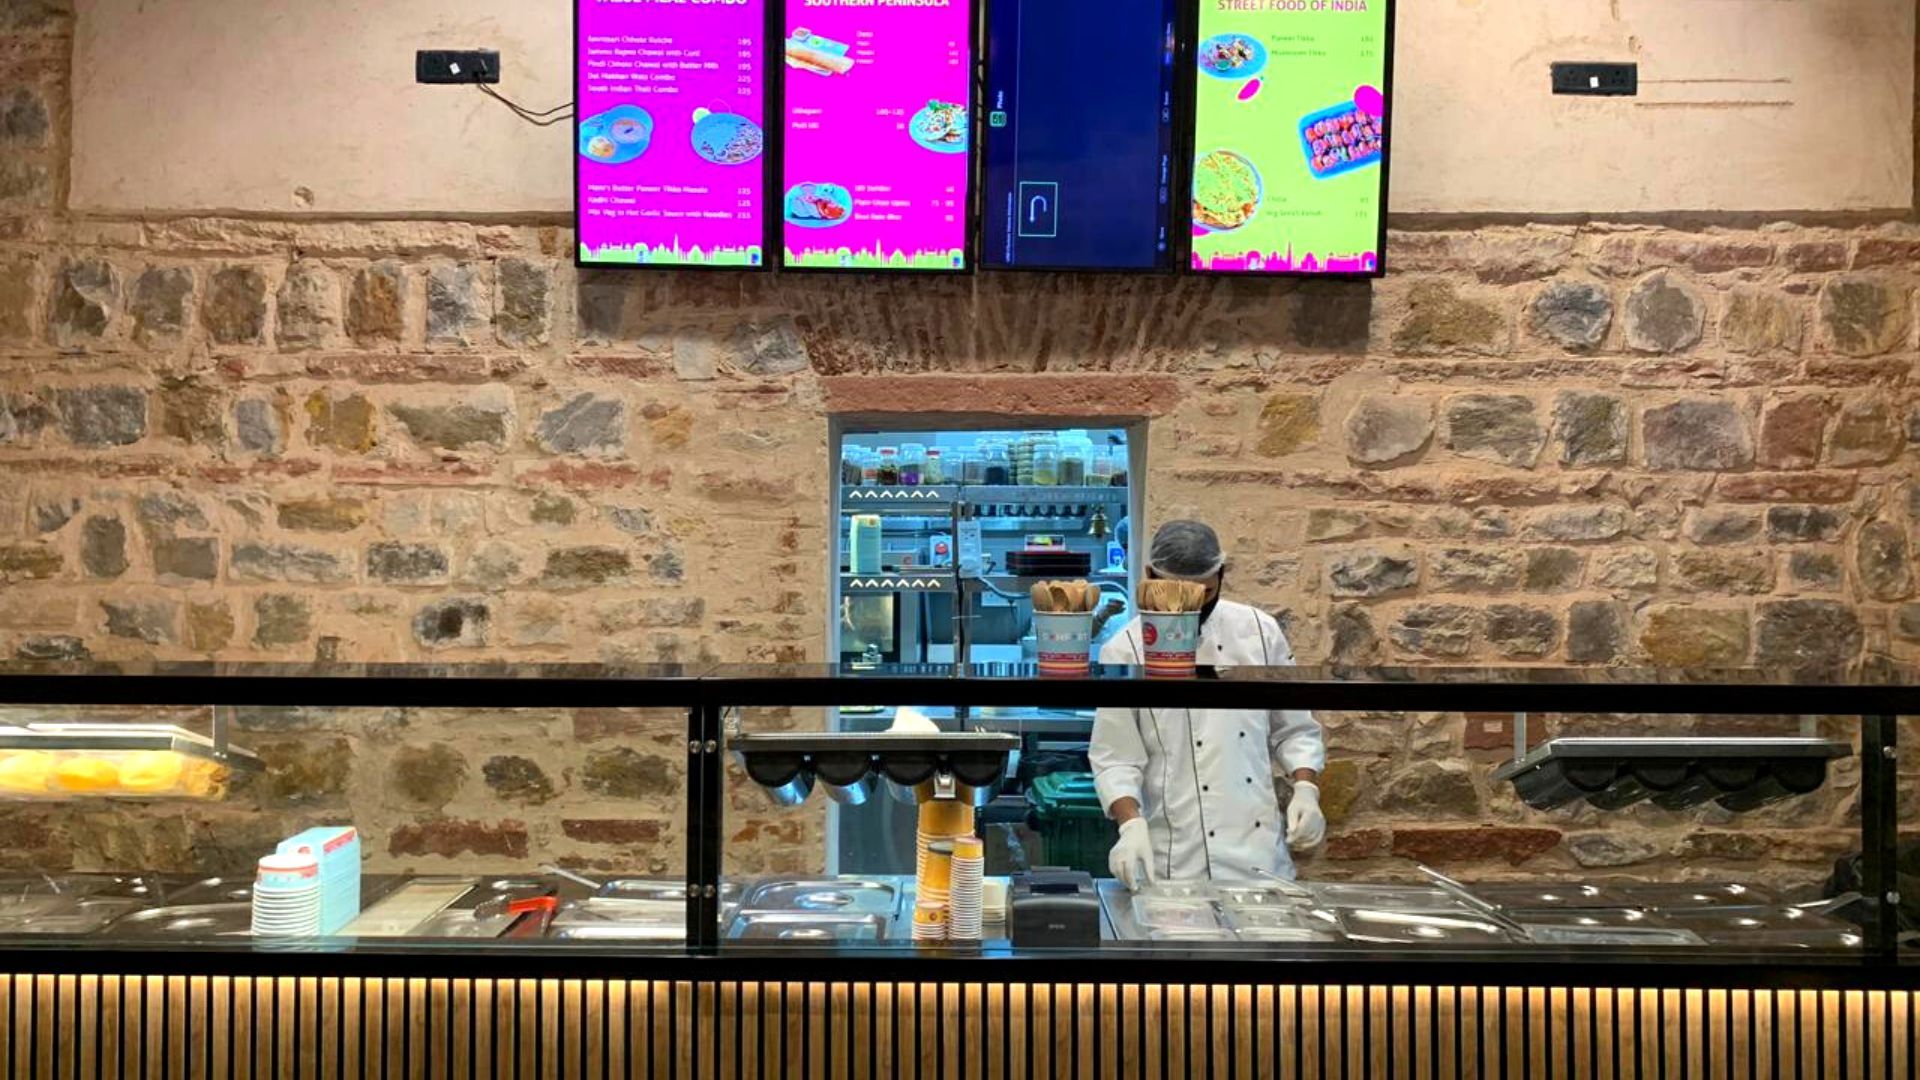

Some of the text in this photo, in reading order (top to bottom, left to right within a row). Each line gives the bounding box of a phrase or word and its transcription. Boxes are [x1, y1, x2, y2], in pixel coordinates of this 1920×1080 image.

[1218, 0, 1367, 12] STREET FOOD OF INDIA
